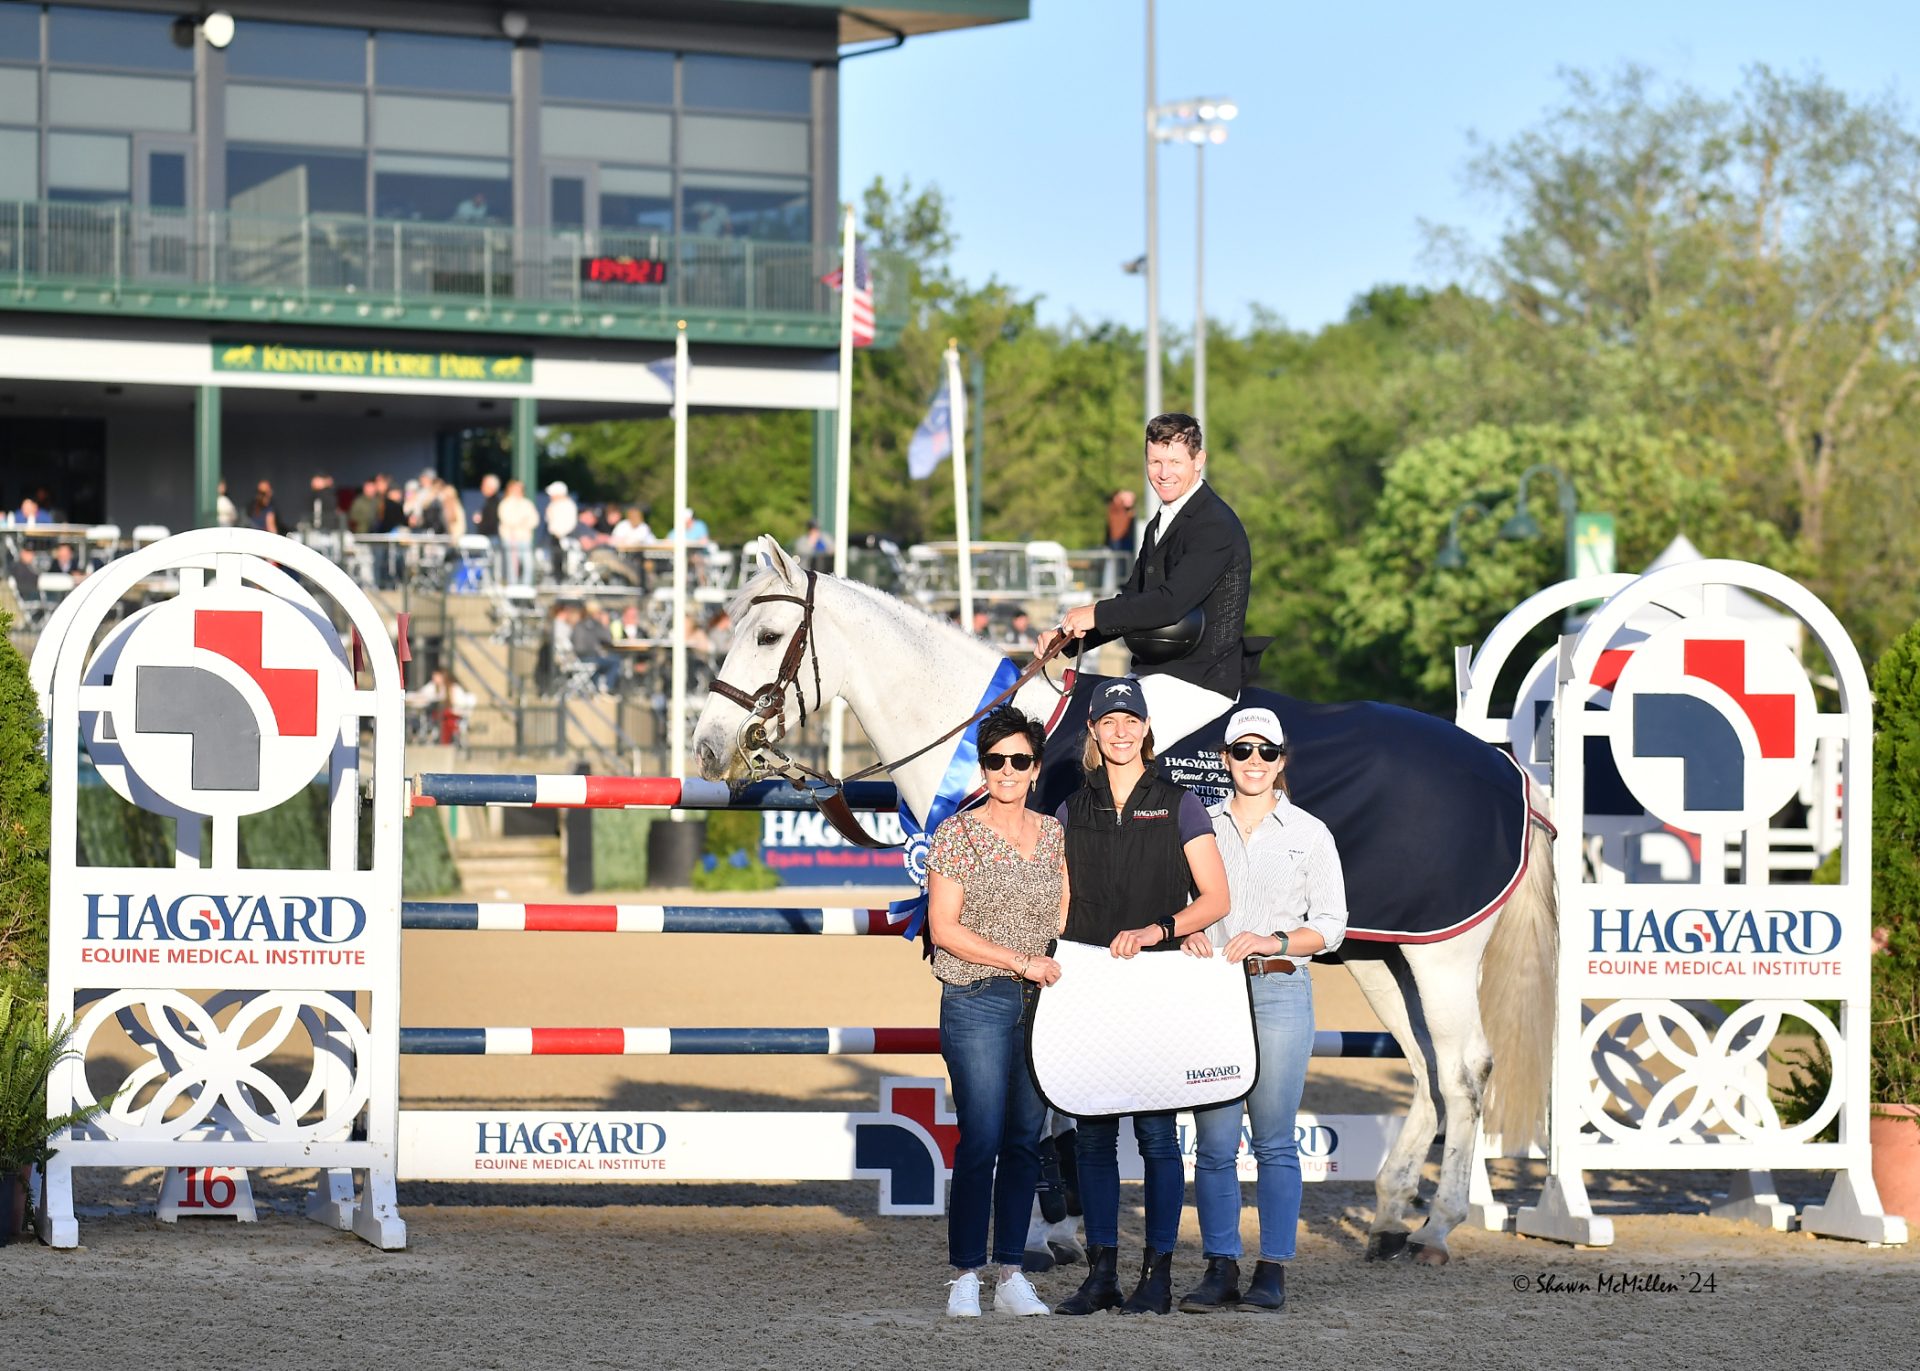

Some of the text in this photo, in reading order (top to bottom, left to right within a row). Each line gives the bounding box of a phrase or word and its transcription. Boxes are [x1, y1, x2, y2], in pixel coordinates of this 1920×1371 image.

[262, 345, 486, 378] KENTUCKY HORSE PARK
[1165, 757, 1226, 770] HAGYARD
[1171, 769, 1231, 783] Grand Prix
[1133, 809, 1169, 817] HAGYARD
[82, 893, 367, 943] HAGYARD
[1588, 908, 1842, 955] HAGYARD
[81, 948, 365, 965] EQUINE MEDICAL INSTITUTE
[1588, 960, 1842, 975] EQUINE MEDICAL INSTITUTE
[1186, 1065, 1240, 1080] HAGYARD
[475, 1121, 667, 1155] HAGYARD
[475, 1159, 666, 1170] EQUINE MEDICAL INSTITUTE
[178, 1167, 236, 1208] 16
